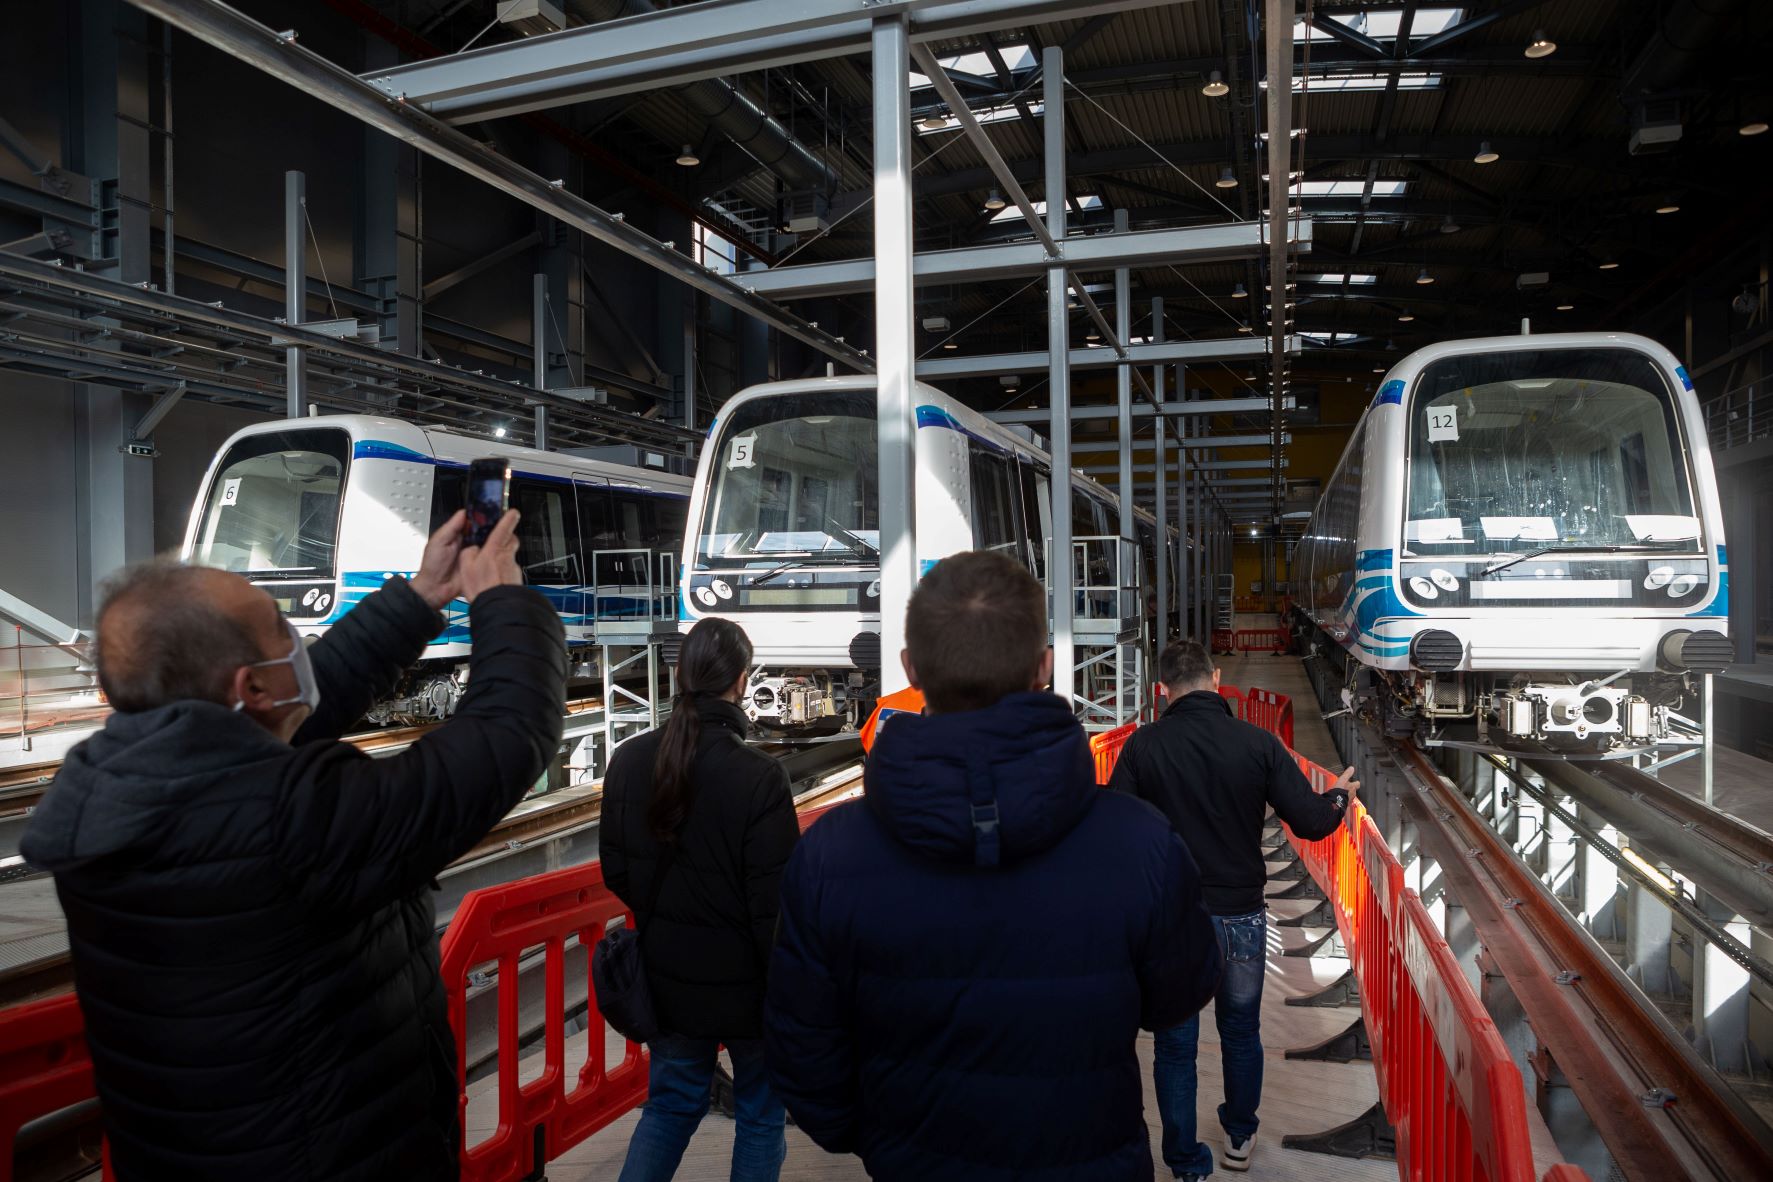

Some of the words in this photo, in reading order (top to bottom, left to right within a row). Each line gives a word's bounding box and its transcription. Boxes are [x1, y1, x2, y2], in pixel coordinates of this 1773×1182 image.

[1432, 414, 1454, 429] 12
[736, 445, 747, 461] 5
[226, 486, 235, 499] 6
